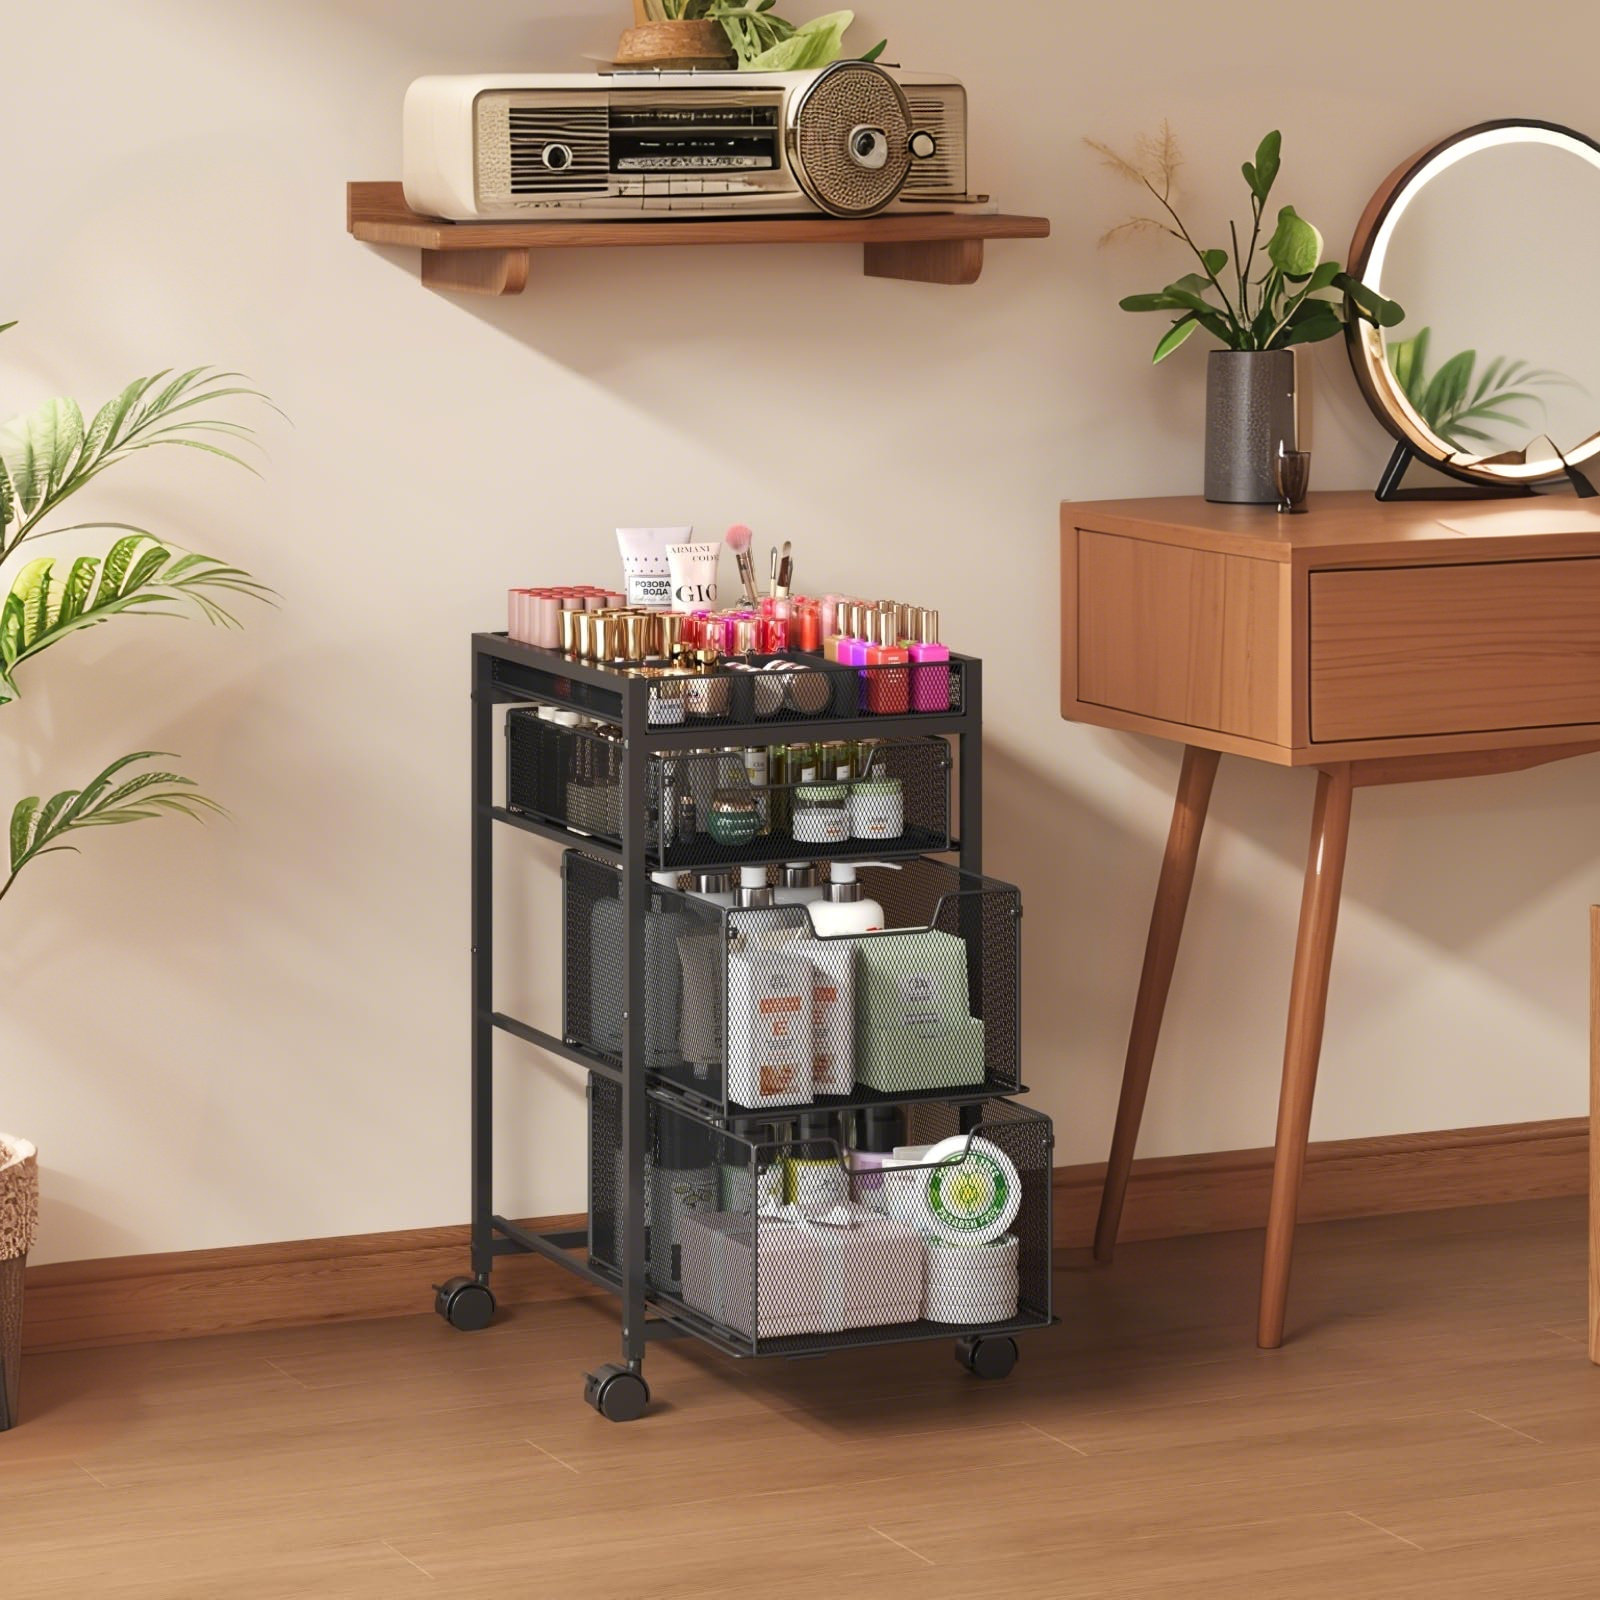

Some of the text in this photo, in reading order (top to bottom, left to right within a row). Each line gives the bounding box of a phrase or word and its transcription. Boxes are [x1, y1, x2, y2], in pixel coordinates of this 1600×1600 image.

[671, 545, 710, 553] ARMANI
[635, 580, 671, 588] РОЗОВА
[643, 588, 668, 596] ВОДА
